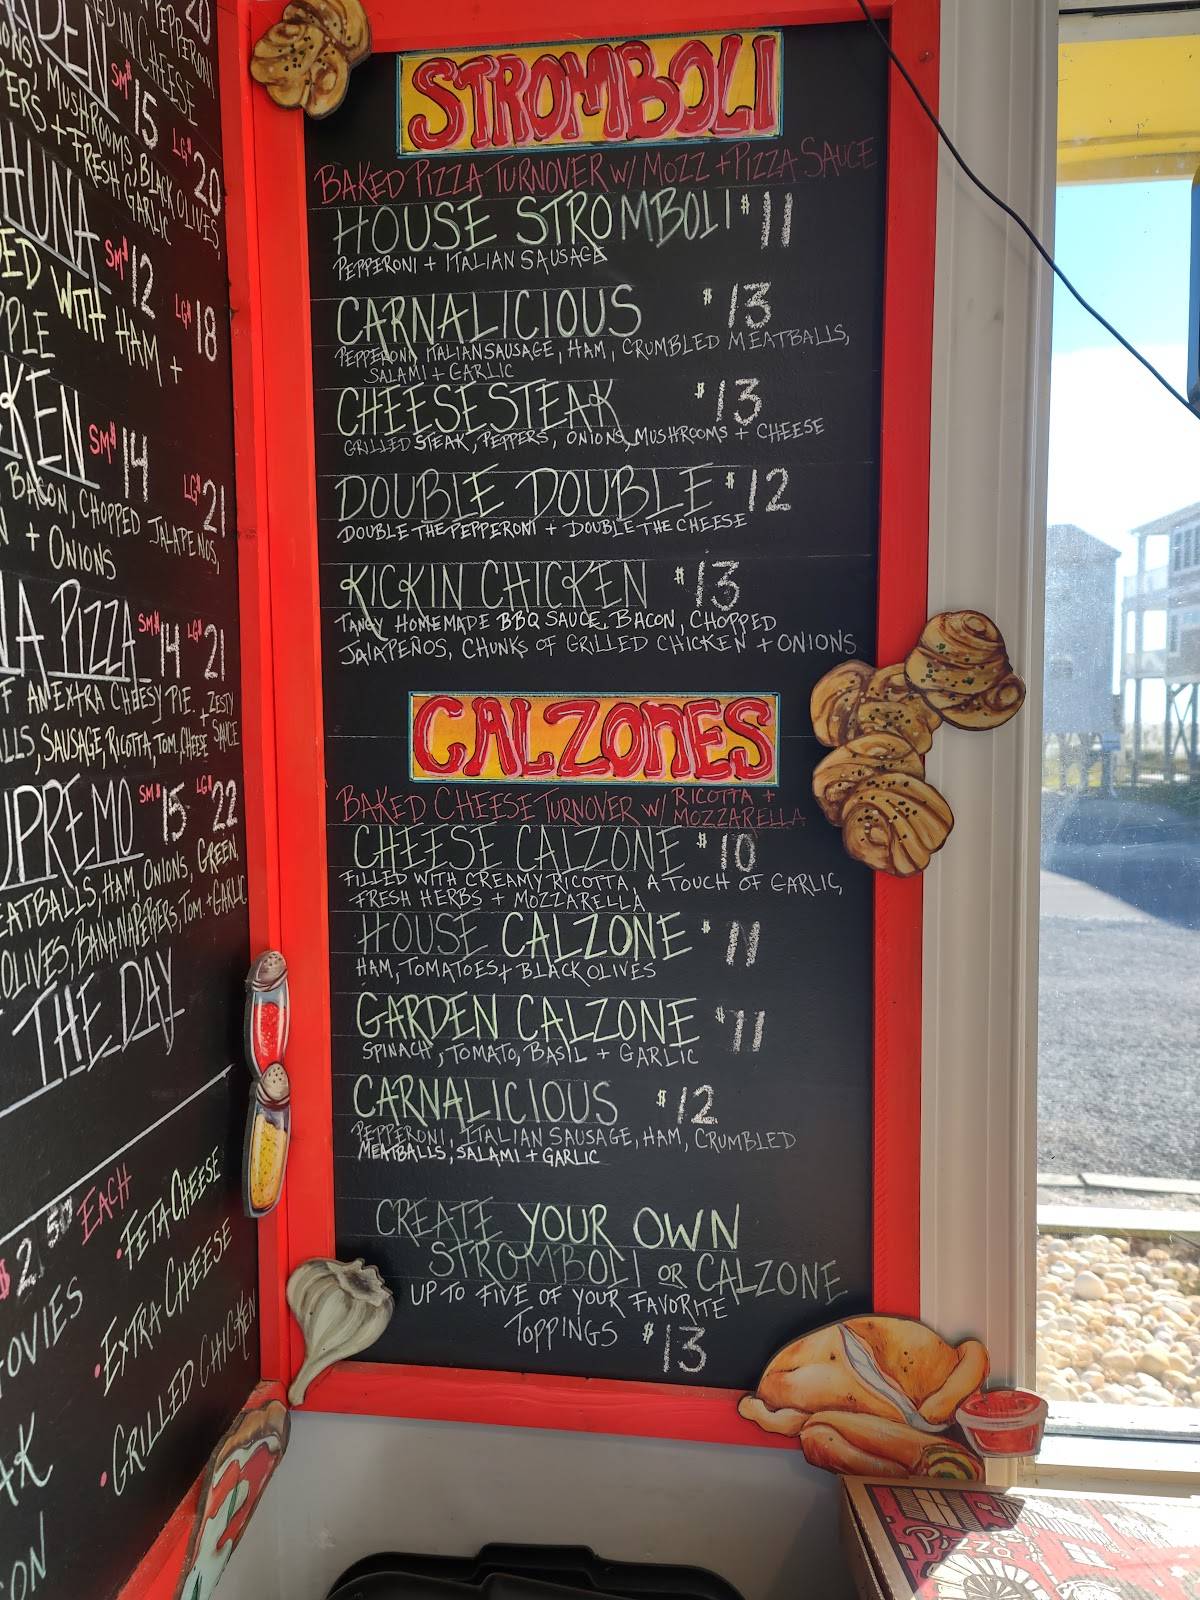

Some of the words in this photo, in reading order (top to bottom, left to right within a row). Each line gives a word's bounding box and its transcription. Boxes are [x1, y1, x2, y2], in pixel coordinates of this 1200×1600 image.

[408, 35, 776, 150] STROMBOLI
[315, 163, 405, 205] BAKED
[415, 160, 482, 198] PIZZA
[495, 154, 607, 193] TURNOVER
[644, 151, 709, 184] MOZZ
[730, 142, 798, 182] PIZZA
[800, 137, 875, 177] SAUCE
[333, 196, 497, 254] HOUSE
[516, 188, 730, 250] STROMBOLI
[333, 256, 416, 280] PEPPERONI
[445, 251, 516, 272] ITALIAN
[520, 245, 608, 274] SAUSAGE
[337, 284, 642, 361] CARNALICIOUS
[335, 346, 417, 368] PEPPERONI,
[567, 339, 616, 364] HAM,
[622, 334, 720, 359] CRUMBLED
[728, 324, 850, 351] MEATBALLS,
[364, 364, 427, 385] SALAMI
[448, 363, 514, 382] GARLIC
[343, 436, 412, 458] GRILLED
[414, 431, 479, 456] STEAK,
[483, 430, 556, 450] PEPPERS,
[565, 429, 631, 452] ONIONS,
[635, 425, 728, 445] MUSHROOMS
[757, 418, 824, 442] CHEESE
[335, 463, 505, 521] DOUBLE
[516, 462, 714, 523] DOUBLE
[338, 520, 412, 542] DOUBLE
[412, 524, 446, 540] THE
[446, 520, 536, 540] PEPPERONI
[562, 519, 636, 537] DOUBLE
[639, 518, 673, 533] THE
[676, 513, 747, 531] CHEESE
[339, 563, 463, 641] KICKIN
[480, 559, 648, 628] CHICKEN
[335, 612, 388, 641] TANGY
[395, 612, 490, 634] HOMEMADE
[496, 609, 540, 632] BBQ
[547, 610, 609, 631] SAUCE,
[608, 609, 684, 635] BACON,
[690, 610, 776, 635] CHOPPED
[461, 633, 528, 661] CHUNKS
[535, 637, 554, 655] OF
[565, 634, 648, 656] GRILLED
[656, 634, 746, 653] CHICKEN
[777, 631, 857, 654] ONIONS
[412, 693, 774, 779] CALZONES
[336, 786, 427, 823] BAKED
[435, 789, 534, 825] CHEESE
[535, 788, 639, 824] TURNOVER
[673, 788, 754, 806] RICOTTA
[673, 809, 808, 828] MOZZARELLA
[352, 821, 506, 874] CHEESE
[515, 823, 685, 879] CALZONE
[338, 870, 408, 891] FILLED
[413, 872, 458, 887] WITH
[465, 870, 548, 892] CREAMY
[551, 872, 637, 892] RICOTTA,
[646, 874, 660, 892] A
[664, 876, 729, 892] TOUCH
[739, 875, 761, 891] OF
[770, 872, 843, 895] GARLIC,
[350, 889, 412, 908] FRESH
[419, 887, 483, 907] HERBS
[514, 891, 646, 913] MOZZARELLA
[355, 907, 488, 957] HOUSE
[501, 911, 693, 961] CALZONE
[355, 957, 400, 983] HAM,
[403, 957, 497, 982] TOMATOES
[518, 959, 589, 986] BLACK
[586, 960, 657, 981] OLIVES
[354, 991, 500, 1042] GARDEN
[516, 993, 700, 1048] CALZONE
[362, 1043, 445, 1067] SPINACH,
[447, 1045, 521, 1065] TOMATO,
[523, 1044, 587, 1063] BASIL
[620, 1044, 698, 1066] GARLIC
[352, 1074, 619, 1126] CARNALICIOUS
[351, 1121, 454, 1146] PEPPERONI,
[460, 1121, 543, 1147] ITALIAN
[548, 1128, 638, 1149] SAUSAGE,
[643, 1128, 689, 1151] HAM,
[696, 1129, 796, 1152] CRUMBLED
[357, 1143, 455, 1165] MEATBALLS,
[457, 1146, 520, 1165] SALAMI
[543, 1148, 600, 1168] GARLIC
[375, 1197, 503, 1246] CREATE
[518, 1203, 625, 1261] YOUR
[633, 1203, 741, 1250] OWN
[428, 1241, 640, 1289] STROMBOLI
[657, 1262, 684, 1289] OR
[697, 1252, 848, 1305] CALZONE
[410, 1280, 436, 1306] UP
[440, 1284, 465, 1301] TO
[475, 1284, 529, 1308] FIVE
[539, 1288, 561, 1306] OF
[573, 1288, 625, 1317] YOUR
[629, 1291, 728, 1324] FAVORITE
[503, 1307, 618, 1352] TOPPINGS
